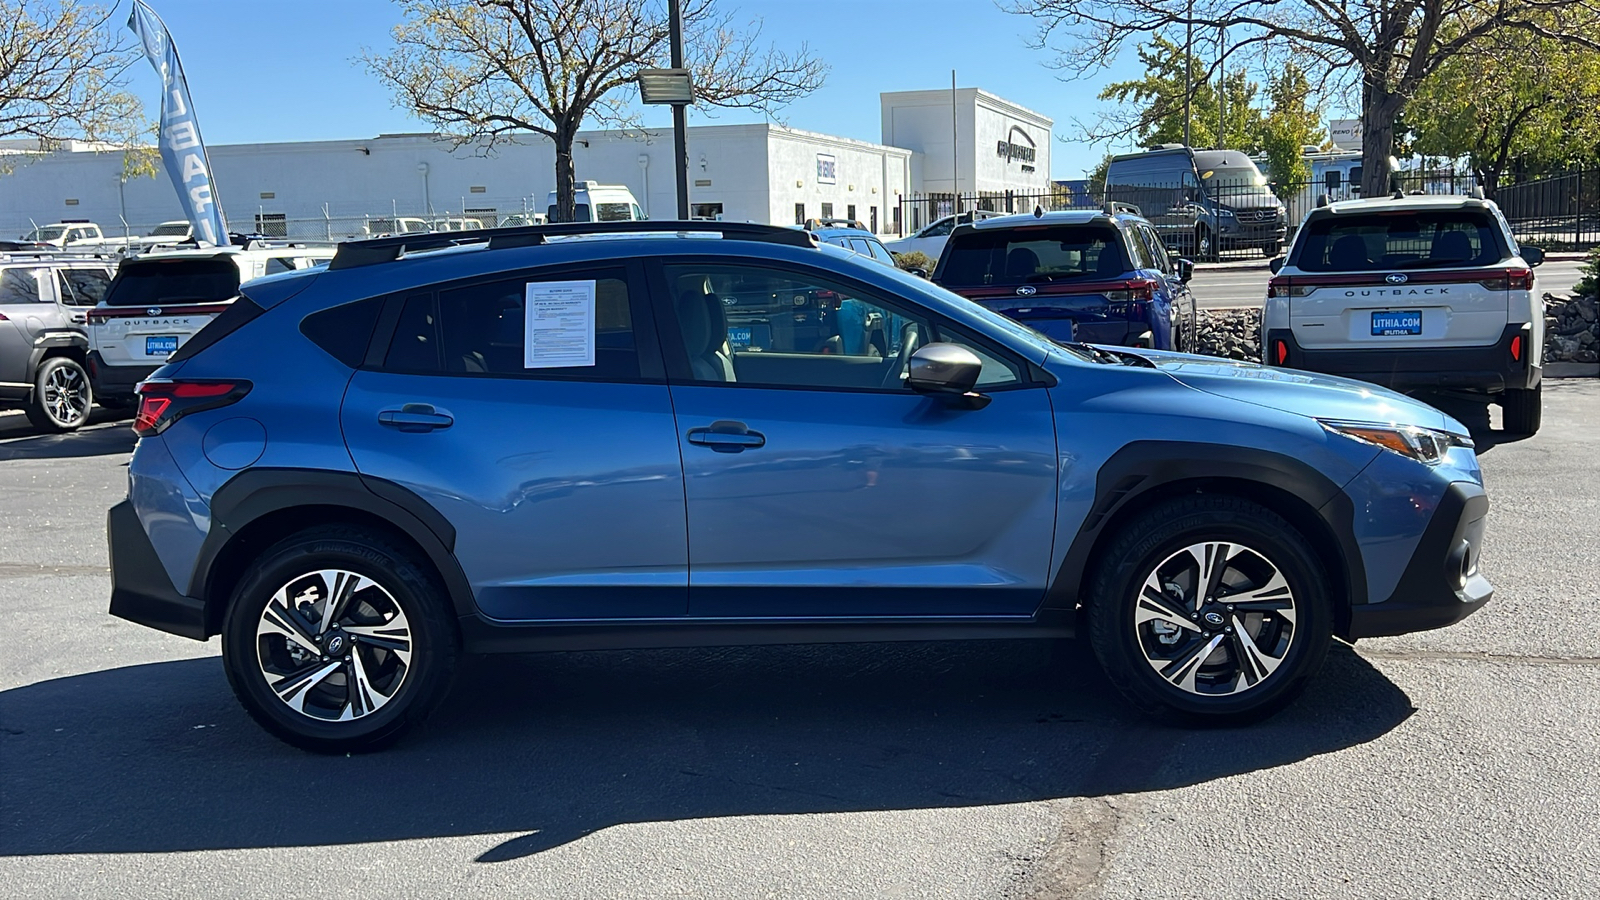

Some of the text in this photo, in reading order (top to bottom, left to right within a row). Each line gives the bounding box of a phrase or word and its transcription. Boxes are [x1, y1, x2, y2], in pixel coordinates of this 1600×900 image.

[1344, 287, 1450, 297] OUTBACK
[1372, 317, 1421, 328] LITHIA.COM
[147, 341, 177, 350] LITHIA.COM
